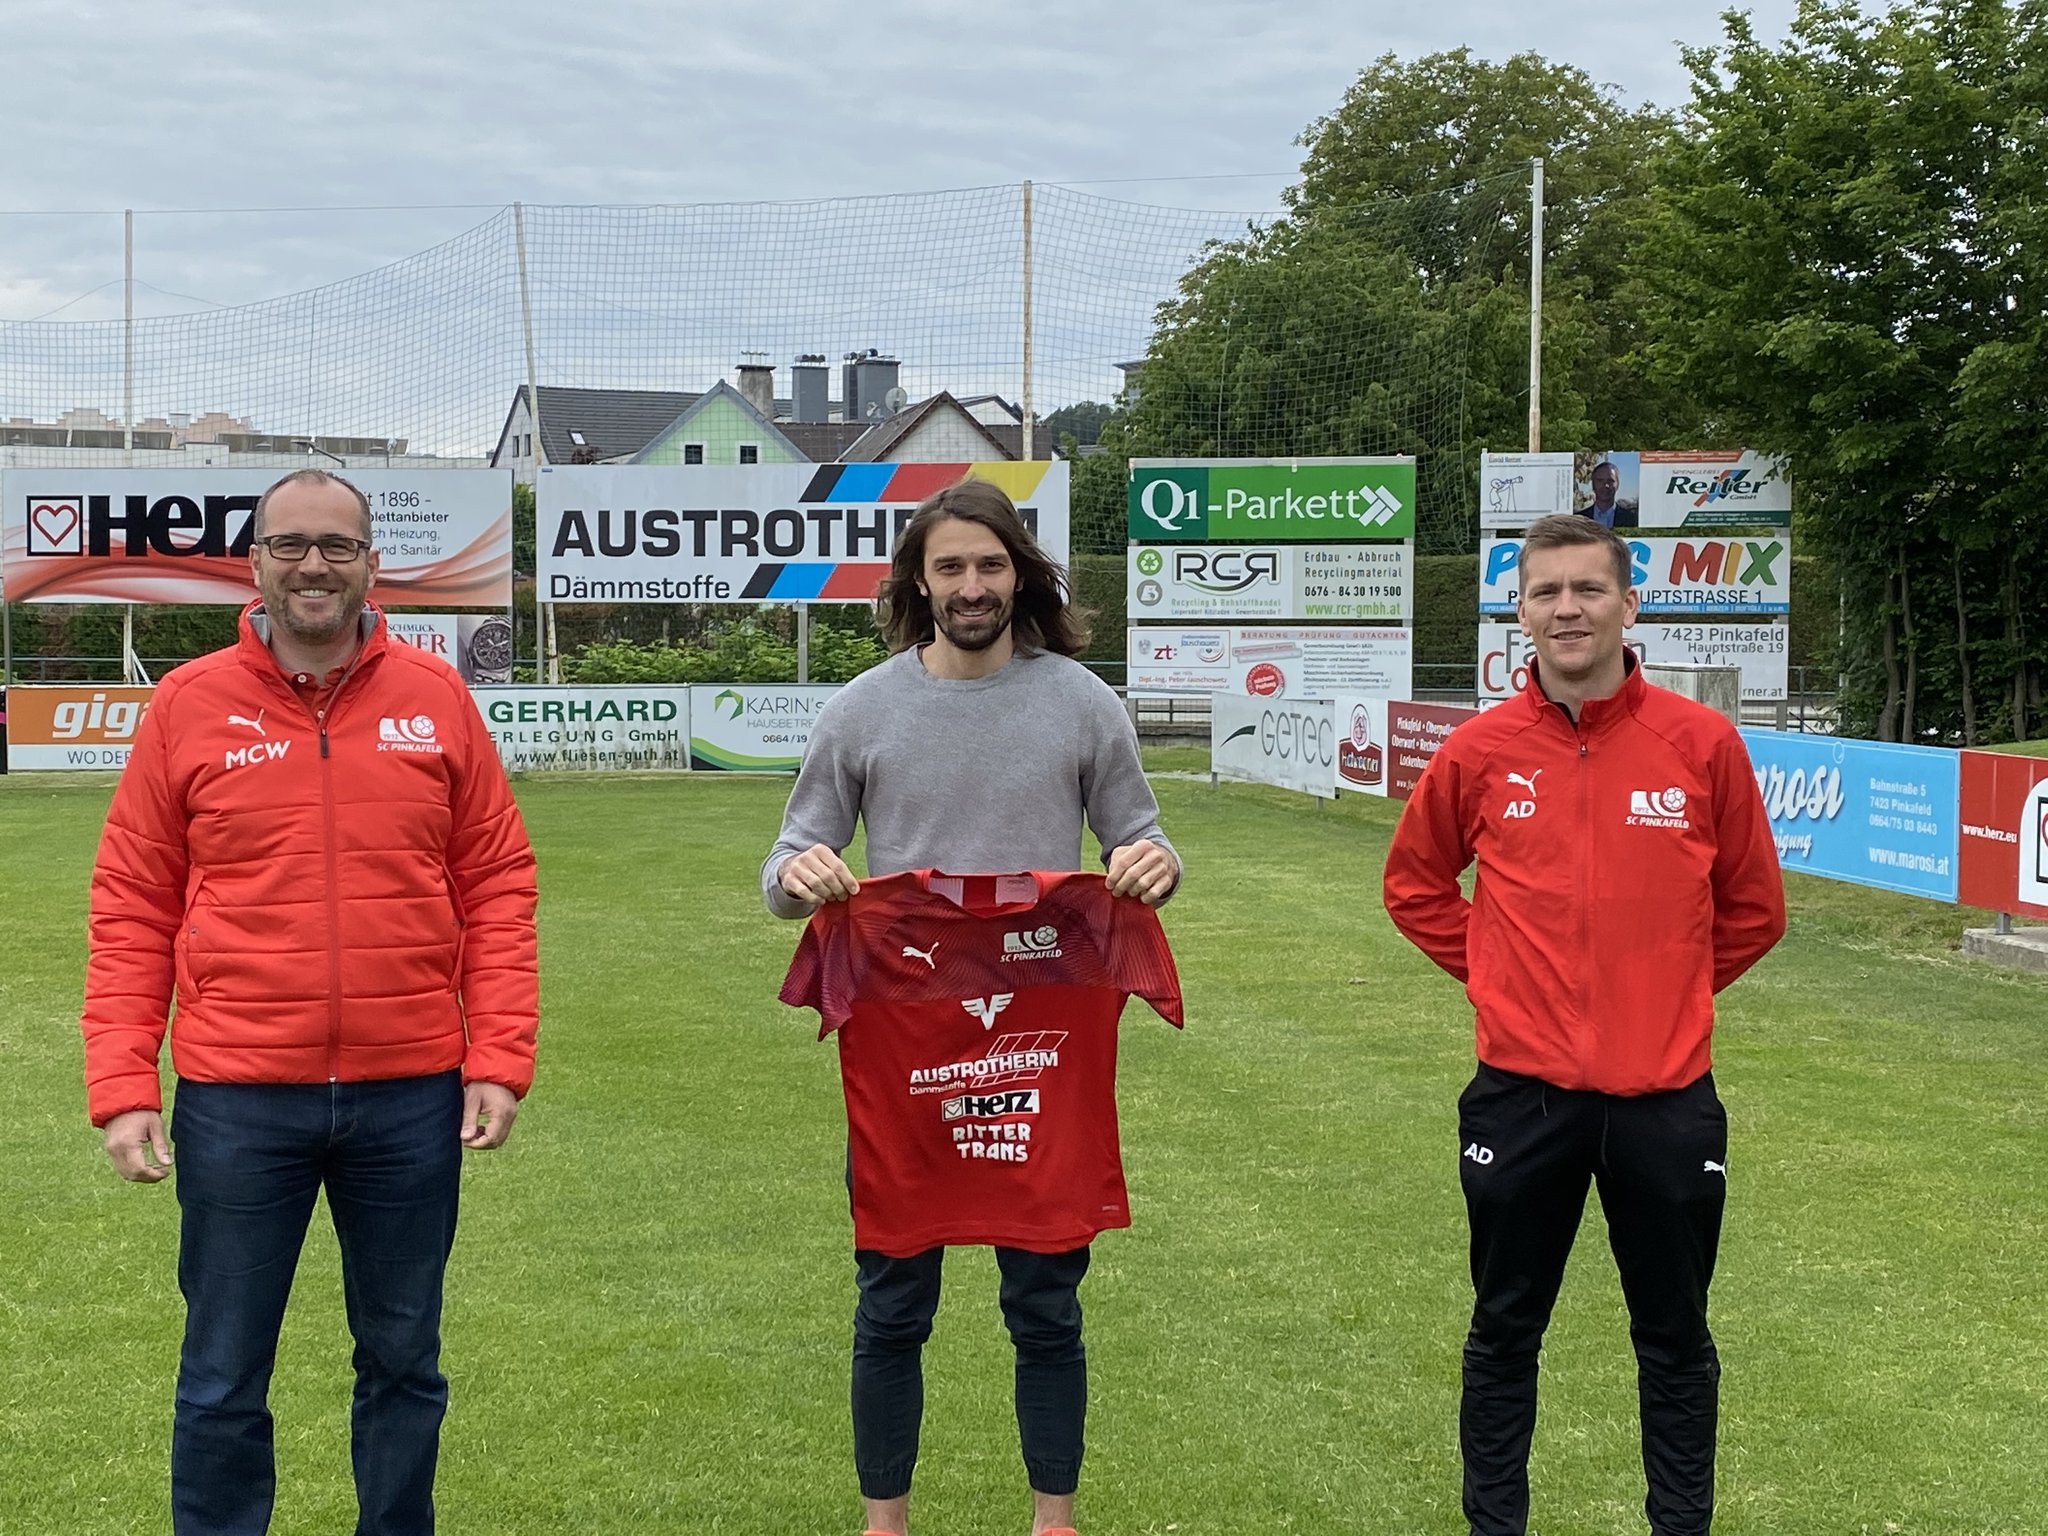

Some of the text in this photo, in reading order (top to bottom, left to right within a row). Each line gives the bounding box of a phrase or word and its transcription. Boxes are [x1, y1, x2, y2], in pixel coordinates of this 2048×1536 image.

[1666, 475, 1768, 495] Reiter
[379, 491, 420, 507] 1896
[369, 511, 449, 523] lettanbieter
[389, 528, 440, 541] Heizung,
[552, 508, 1038, 557] AUSTROTH
[401, 544, 442, 556] Sanitär
[1304, 551, 1401, 562] Erdbau Abbruch
[1669, 541, 1784, 586] MIX
[1305, 567, 1402, 580] Recyclingmaterial
[550, 574, 730, 599] Dämmstoffe
[1305, 586, 1329, 597] 0676
[1339, 586, 1350, 597] 84
[1354, 586, 1365, 597] 30
[1369, 586, 1380, 597] 19
[1383, 586, 1401, 597] 500
[1640, 590, 1762, 604] UPTSTRASSE 1
[1305, 601, 1400, 617] www.rcr-gmbh.at
[388, 624, 435, 632] SCHMUCK
[1661, 627, 1784, 642] 7423 Pinkafeld
[1688, 642, 1784, 655] Hauptstraße 19
[1742, 687, 1783, 697] rner.at
[488, 700, 677, 723] GERHARD
[747, 718, 814, 728] HAUSBETRE
[489, 730, 678, 743] ERLEGUNG GmbH
[763, 735, 788, 743] 0664
[225, 740, 291, 770] MCW
[377, 742, 443, 753] SC PINKAFELD
[67, 750, 96, 765] WO
[515, 748, 679, 763] www.fliesen-guth.at
[1754, 763, 1845, 820] rosi
[1870, 777, 1926, 797] Bahnstraße 5
[1503, 800, 1536, 819] AD
[1870, 796, 1932, 816] 7423 Pinkafeld
[1625, 816, 1690, 829] SC PINKAFELD
[1962, 824, 2017, 843] www.herz.eu
[1775, 827, 1813, 858] igung
[1869, 847, 1949, 876] www.marosi.at
[1000, 949, 1062, 963] SC PINKAFELD
[910, 1051, 1058, 1084] AUSTROTHERM
[952, 1122, 1031, 1142] RITTER
[956, 1142, 1028, 1163] TRANS
[1464, 1142, 1494, 1165] AD
